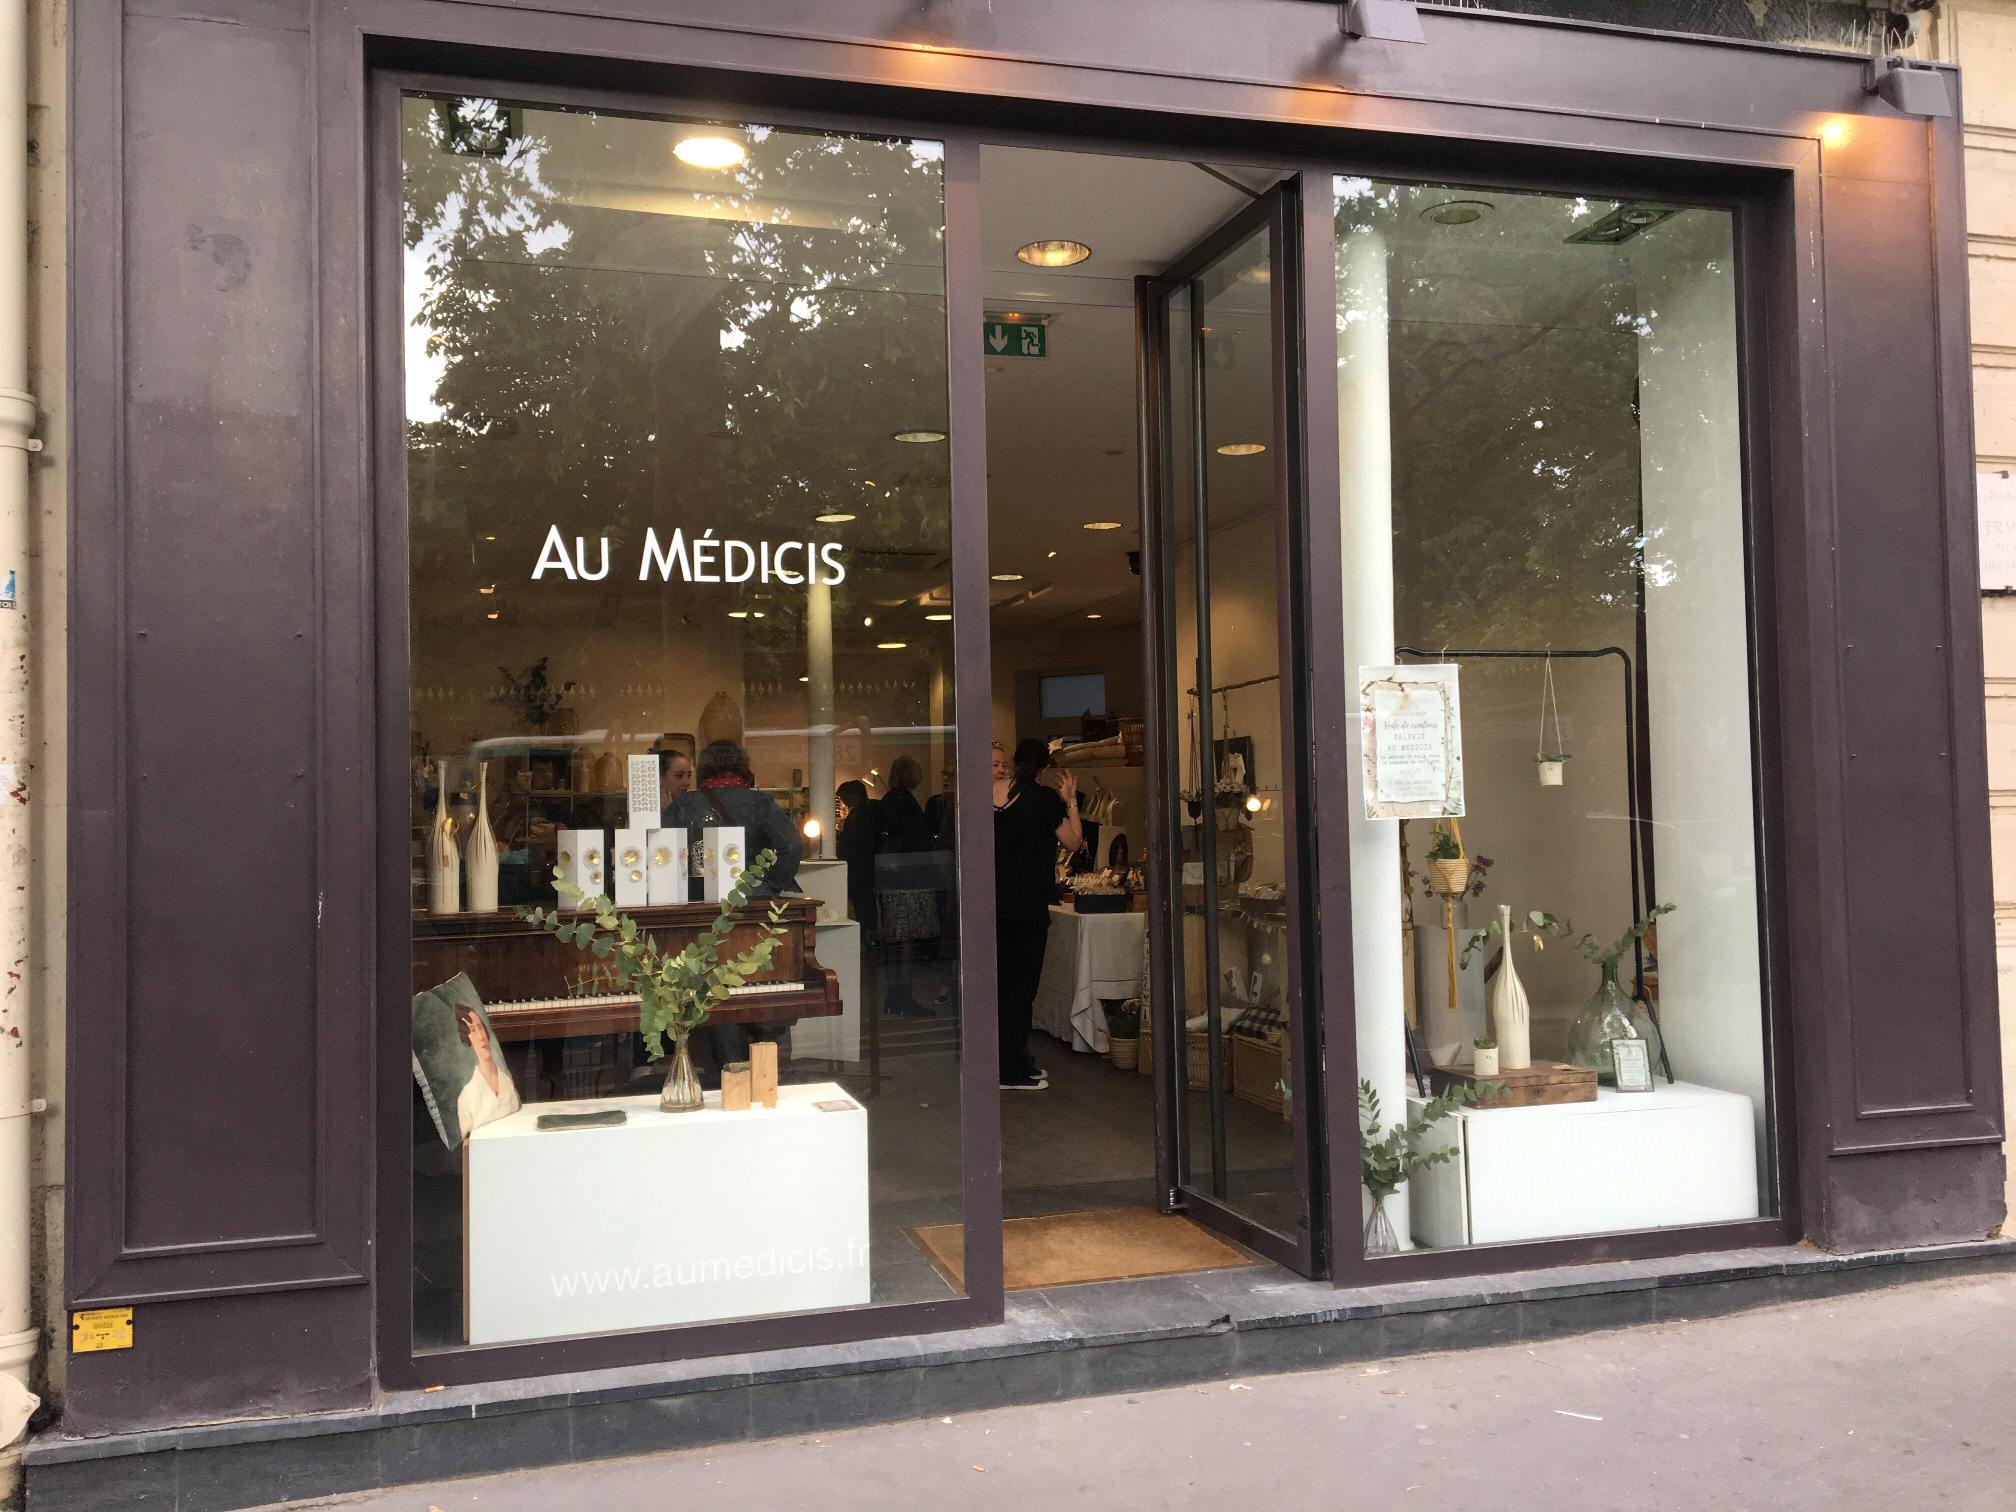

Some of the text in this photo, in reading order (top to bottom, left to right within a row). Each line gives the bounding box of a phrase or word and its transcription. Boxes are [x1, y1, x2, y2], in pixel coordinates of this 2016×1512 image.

[531, 524, 846, 586] AU MÉDICIS
[550, 1237, 871, 1298] www.aumedicis.fr
